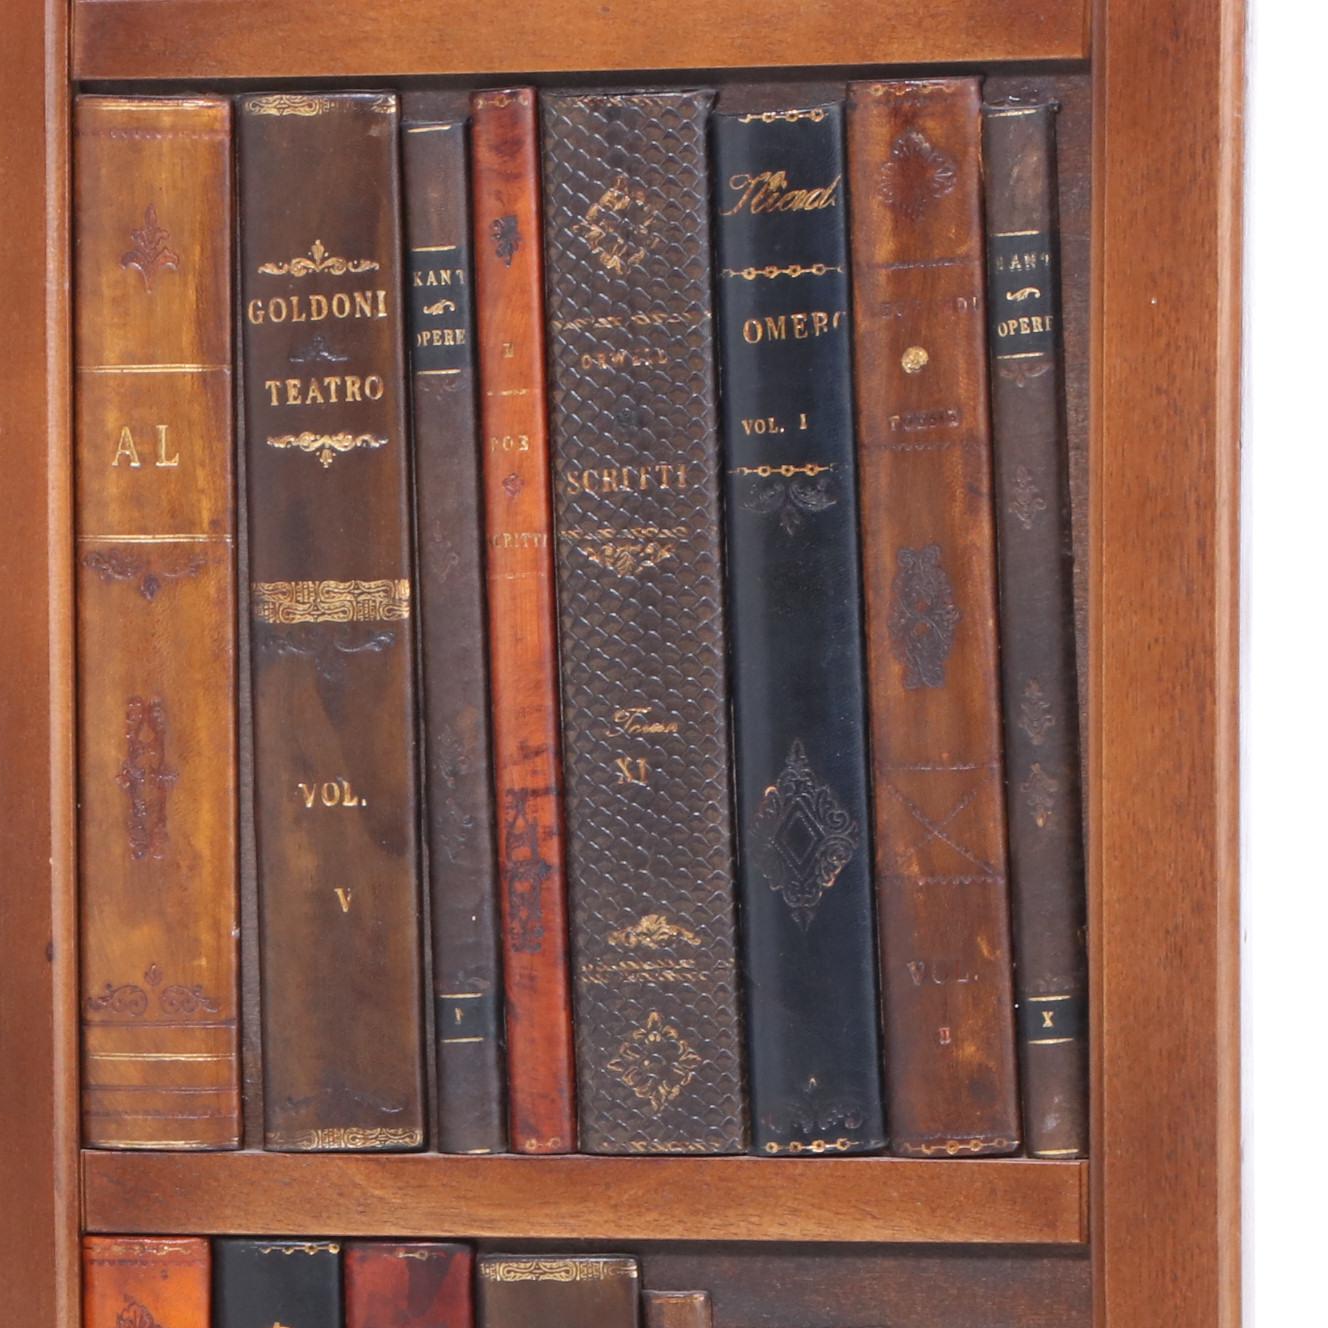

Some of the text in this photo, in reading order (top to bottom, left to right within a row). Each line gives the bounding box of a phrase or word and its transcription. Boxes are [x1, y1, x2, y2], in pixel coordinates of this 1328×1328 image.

[412, 268, 465, 287] KANT
[247, 289, 389, 325] GOLDONI
[264, 374, 386, 407] TEATRO
[741, 415, 785, 435] VOL.
[566, 463, 688, 494] SCRITTI
[297, 780, 368, 808] VOL.
[332, 887, 354, 913] V
[1041, 1010, 1055, 1028] X
